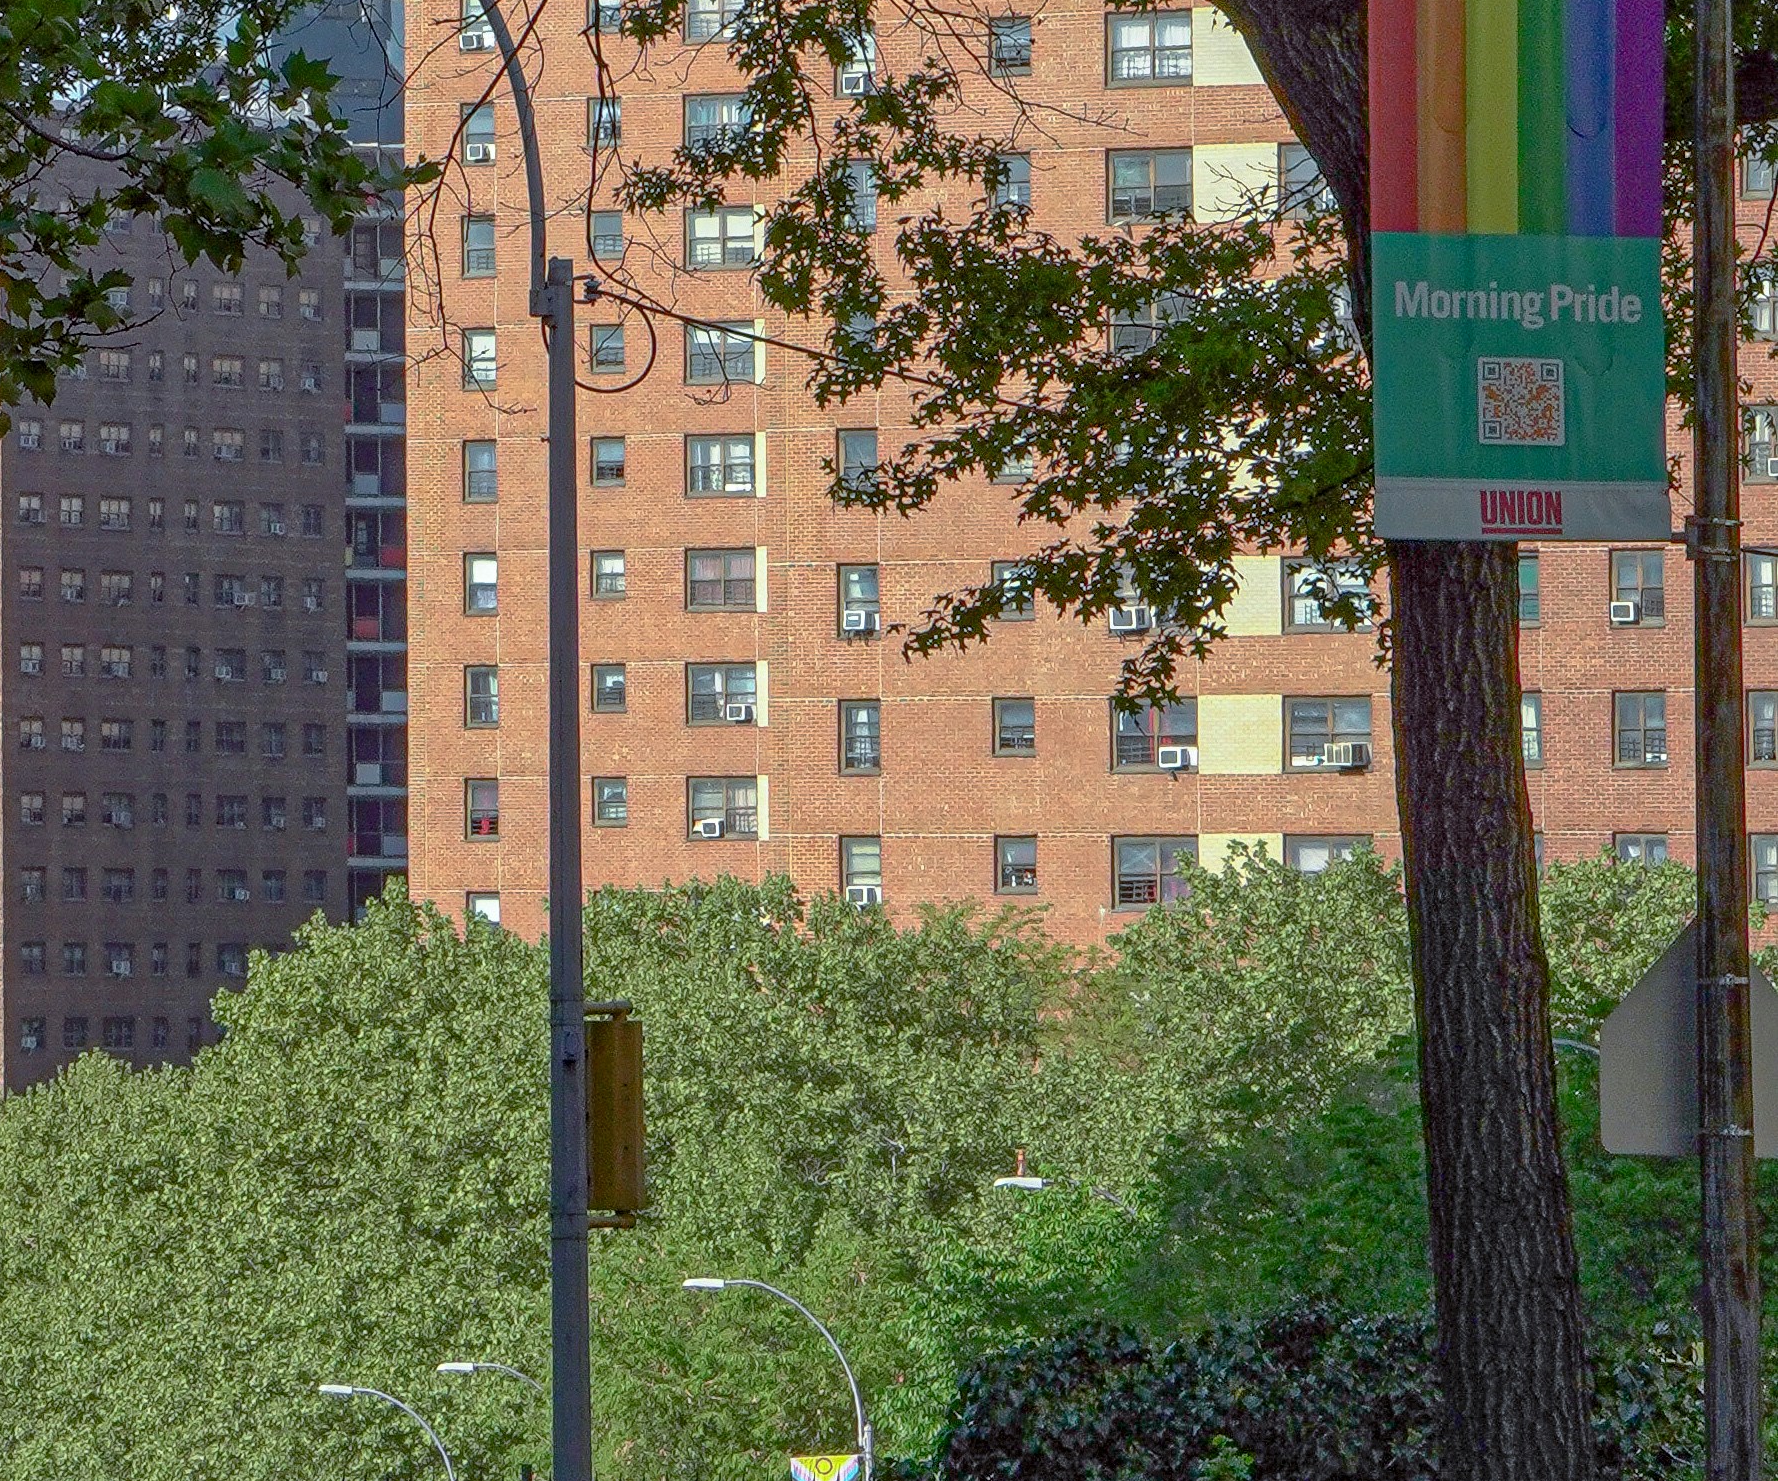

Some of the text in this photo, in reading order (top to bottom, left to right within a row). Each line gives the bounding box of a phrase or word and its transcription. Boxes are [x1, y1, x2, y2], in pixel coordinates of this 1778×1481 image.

[1394, 280, 1643, 330] Morning Pride
[1479, 489, 1563, 526] UNION
